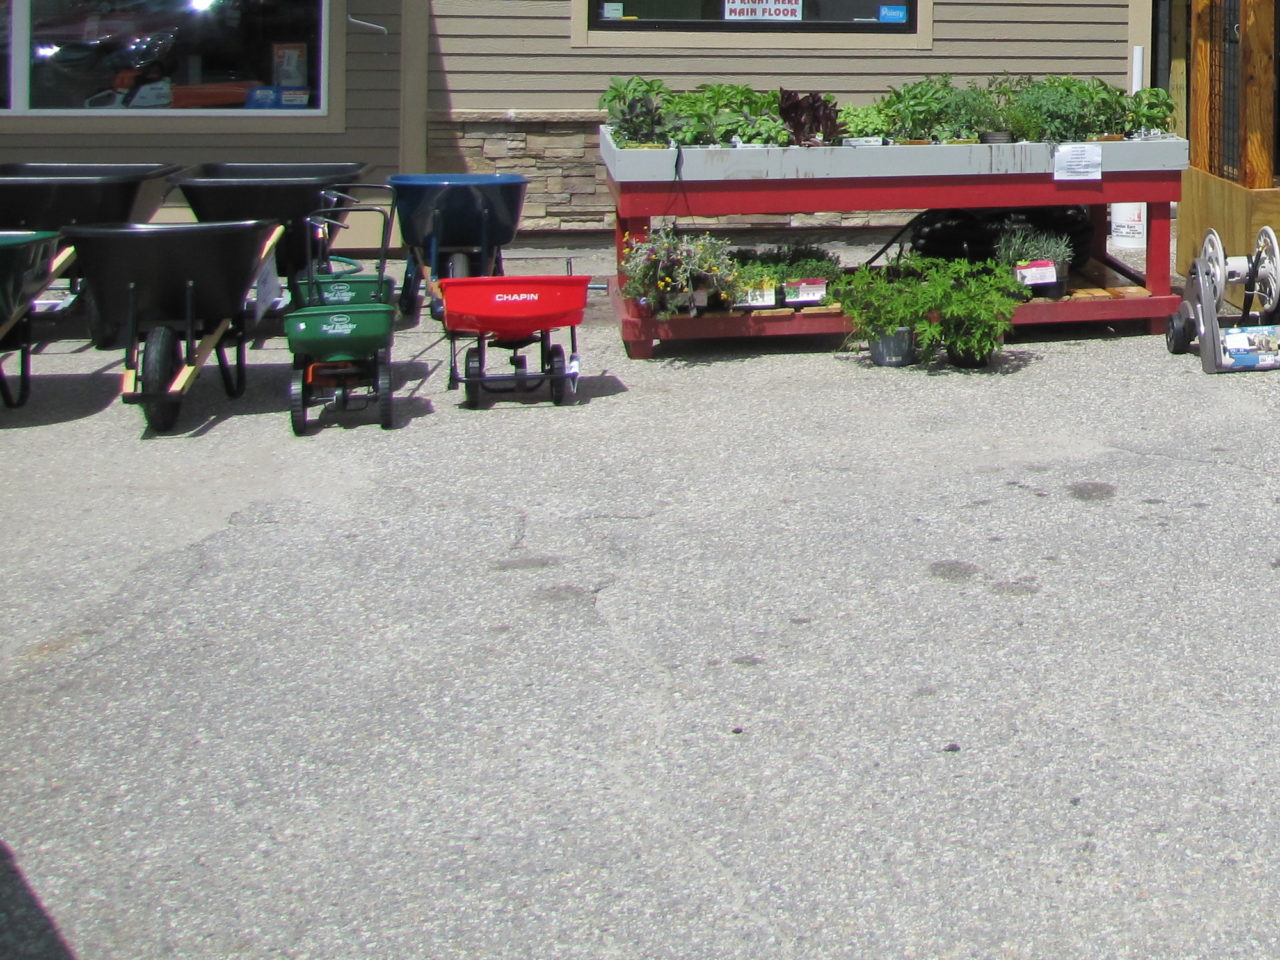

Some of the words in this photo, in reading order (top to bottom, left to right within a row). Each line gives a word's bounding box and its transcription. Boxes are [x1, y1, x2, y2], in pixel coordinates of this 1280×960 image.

[729, 8, 757, 17] MAIN
[762, 8, 797, 17] FLOOR
[495, 293, 539, 302] CHAPIN
